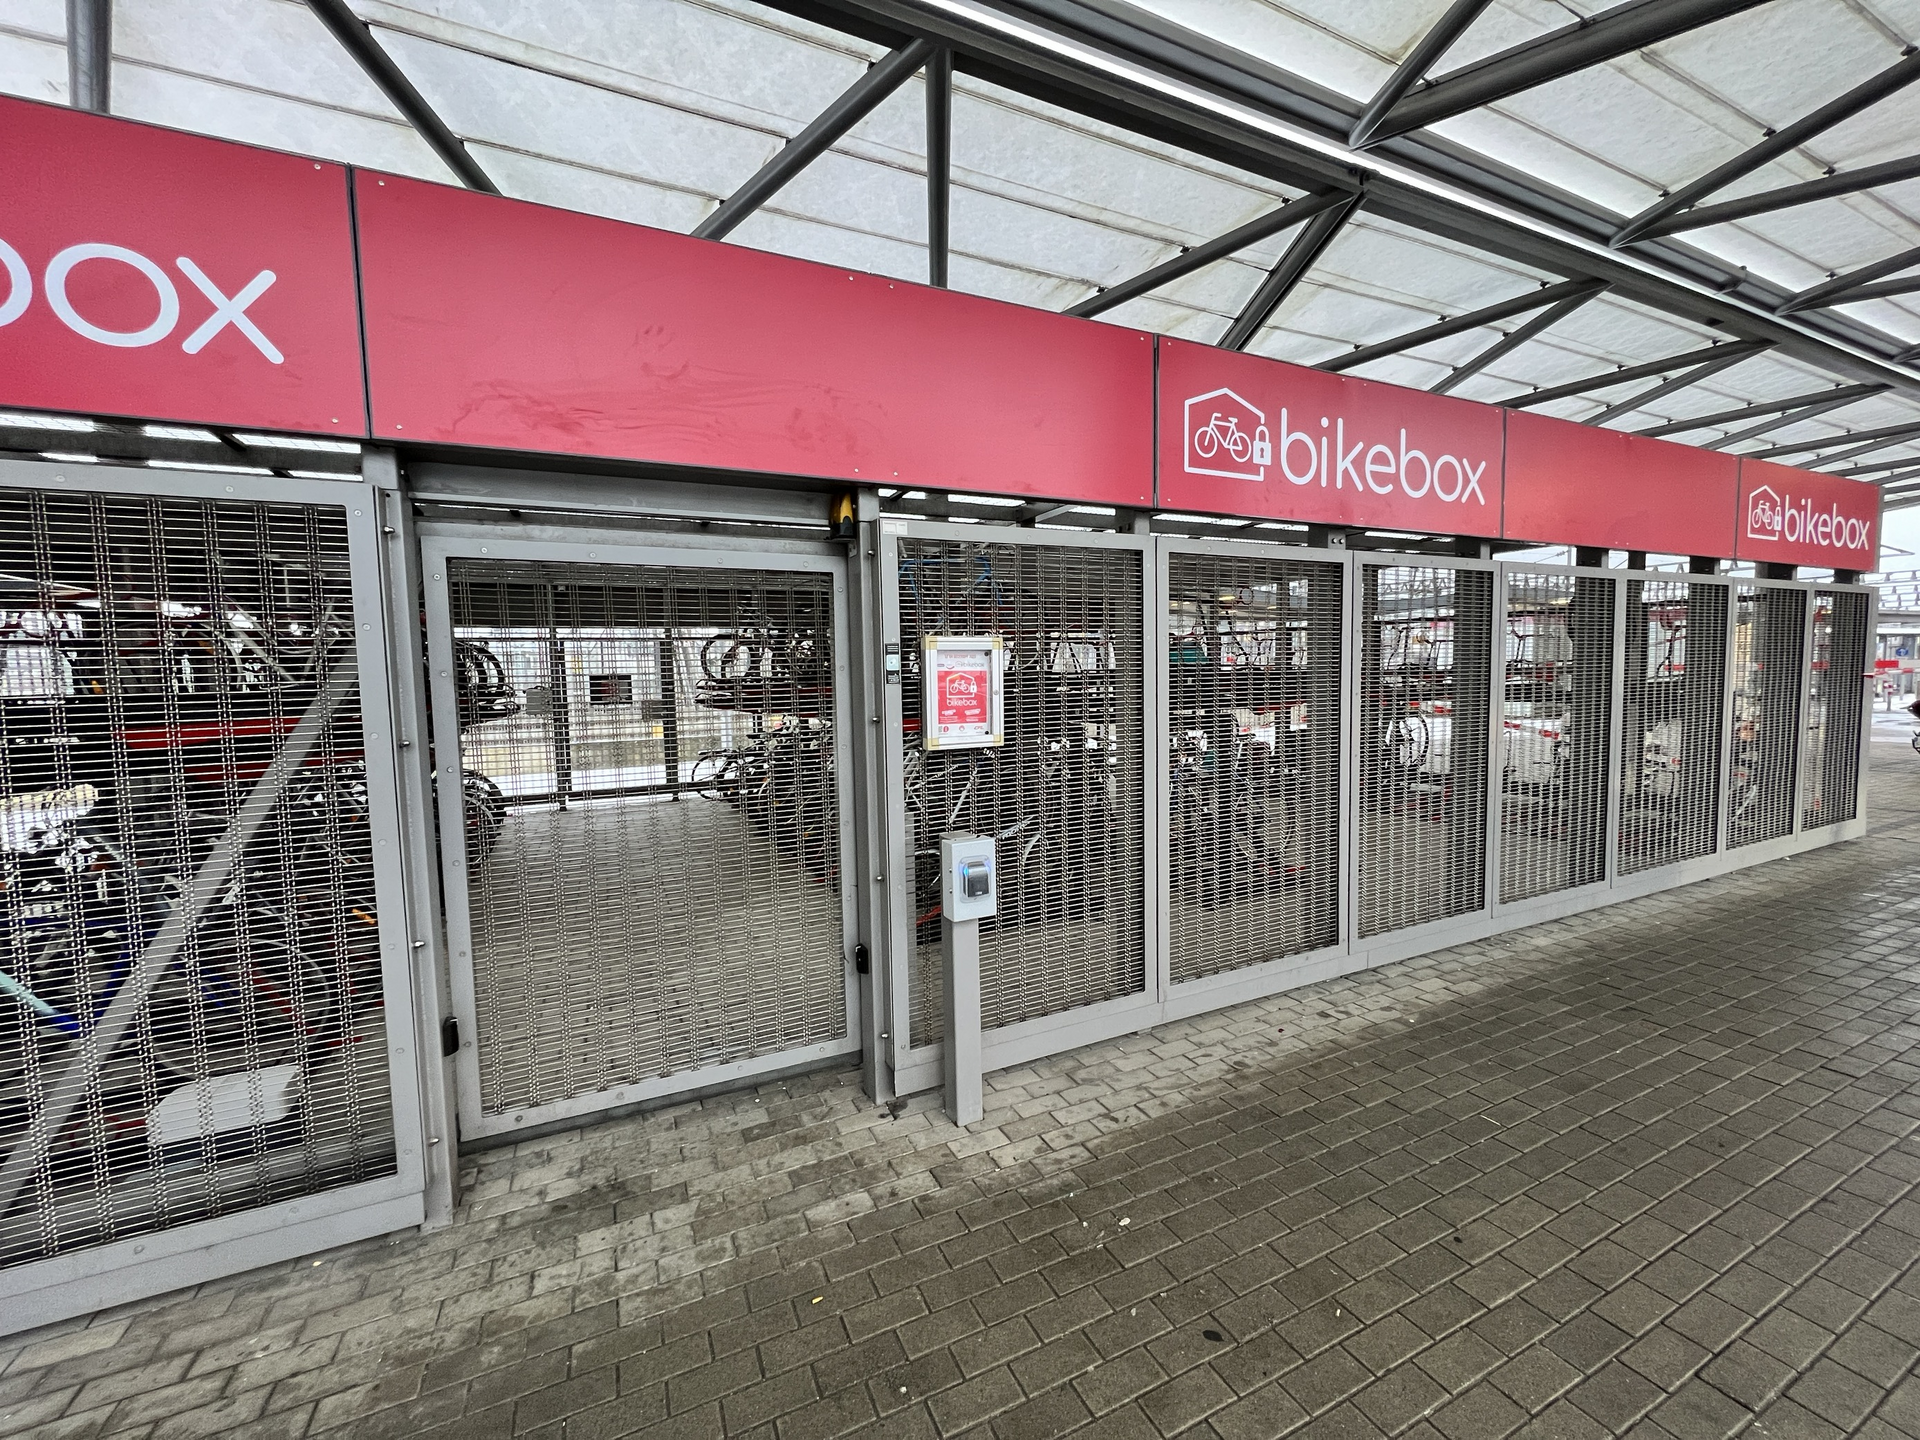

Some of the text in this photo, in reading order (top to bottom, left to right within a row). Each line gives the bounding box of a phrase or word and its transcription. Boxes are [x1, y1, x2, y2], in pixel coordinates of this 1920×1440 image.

[0, 238, 285, 364] ox
[1280, 407, 1486, 506] bikebox
[1784, 494, 1871, 550] bikebox
[946, 698, 978, 707] bikebox
